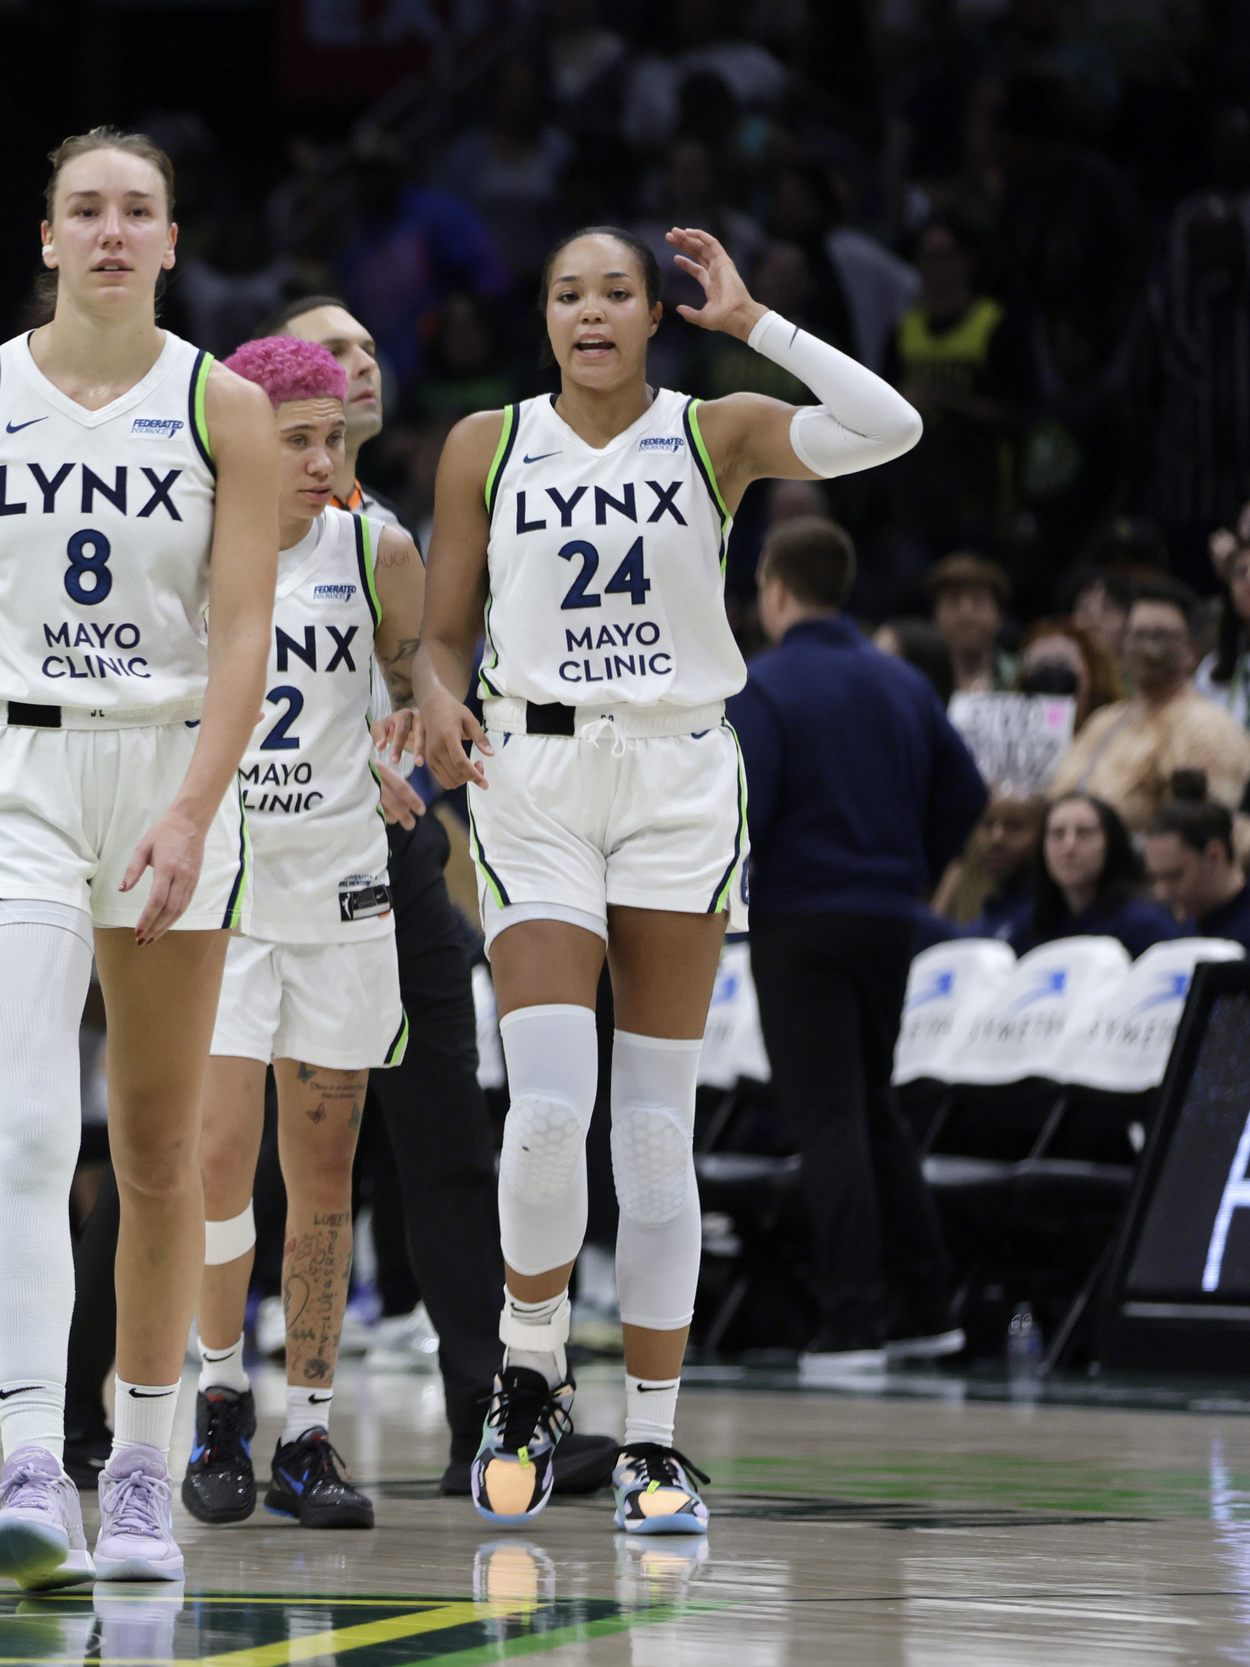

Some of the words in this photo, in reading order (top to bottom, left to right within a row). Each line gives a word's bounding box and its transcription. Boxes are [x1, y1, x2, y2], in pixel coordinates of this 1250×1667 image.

[133, 419, 184, 433] FEDERATED
[639, 438, 684, 449] FEDERATED
[516, 480, 688, 535] LYNX
[64, 528, 112, 605] 8
[557, 536, 651, 610] 24
[314, 585, 357, 597] FEDERATED
[43, 622, 140, 649] MAYO
[275, 625, 359, 673] NX
[565, 621, 660, 652] MAYO
[41, 655, 152, 679] CLINIC
[559, 653, 672, 682] CLINIC
[259, 685, 304, 751] 2
[238, 762, 312, 787] MAYO
[242, 791, 323, 814] LINIC
